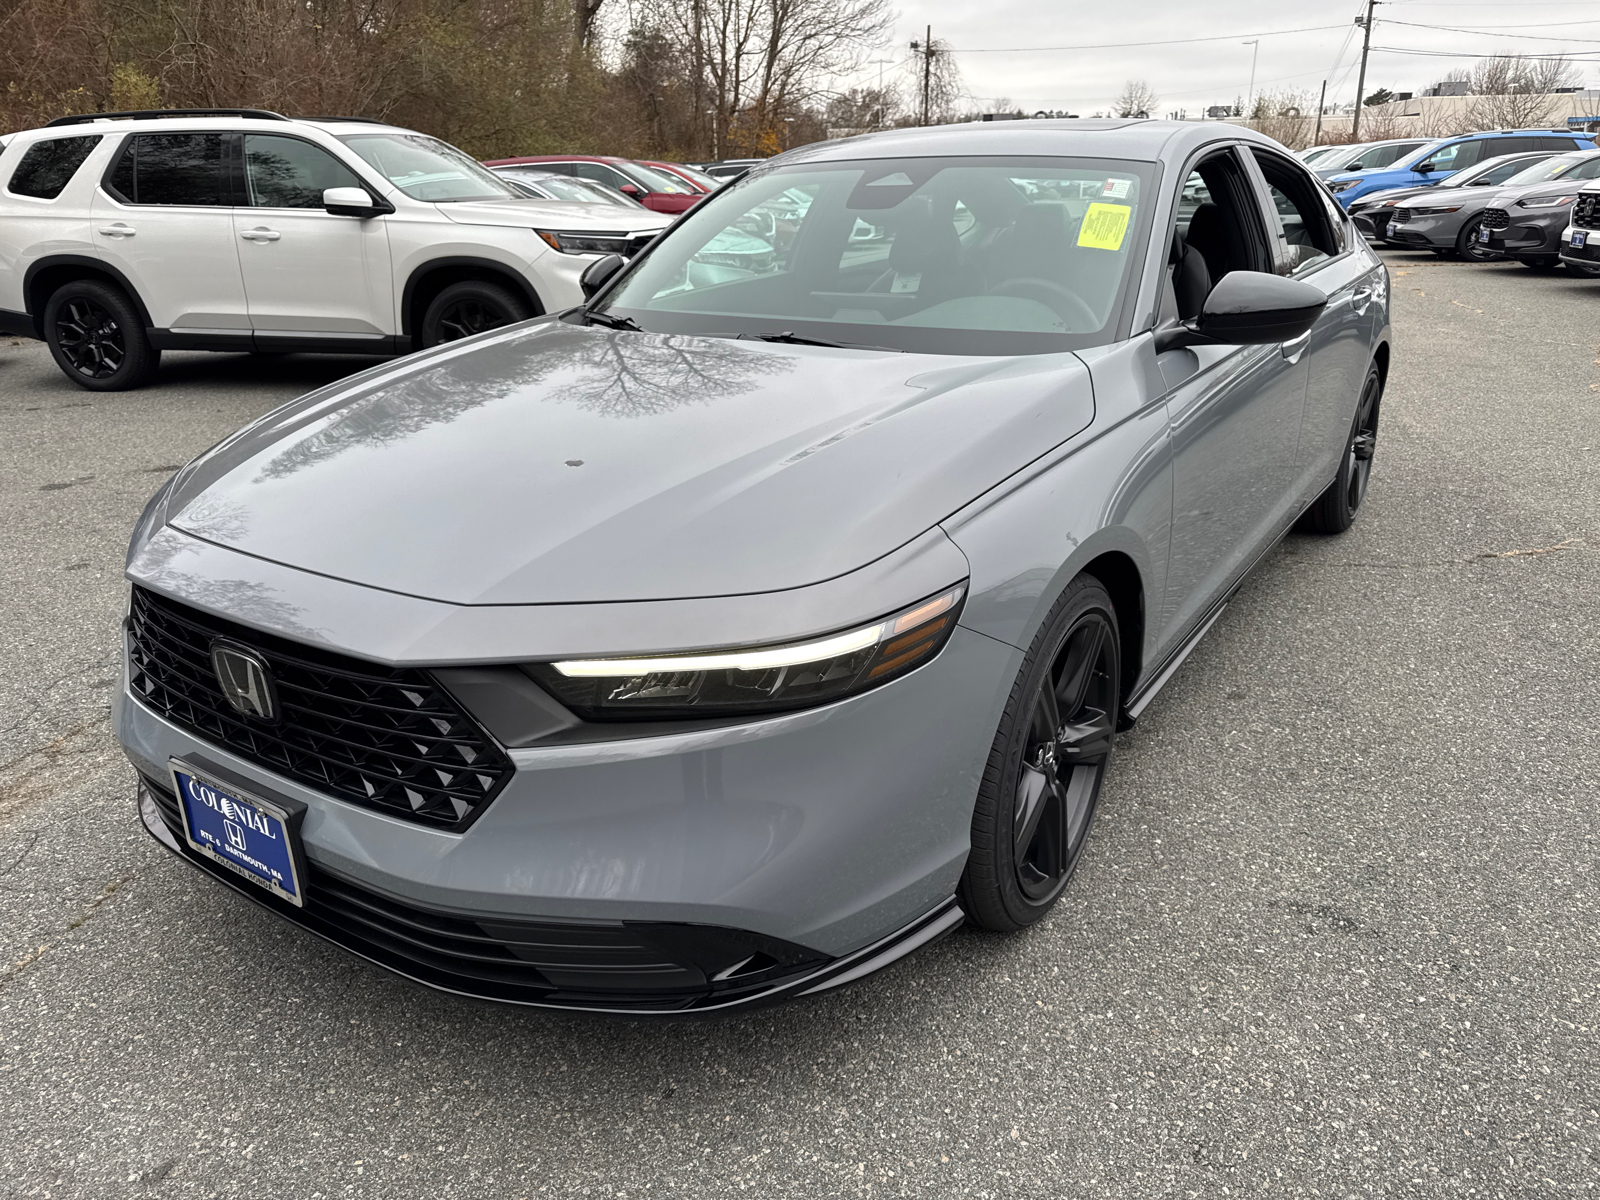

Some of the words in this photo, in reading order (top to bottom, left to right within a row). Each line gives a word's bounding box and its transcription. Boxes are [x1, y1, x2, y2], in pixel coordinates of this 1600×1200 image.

[188, 780, 276, 839] COLONIAL
[213, 854, 247, 878] COLONIAL
[248, 872, 273, 891] HONDA
[224, 844, 270, 875] DARTMOUTH,
[271, 868, 283, 881] MA
